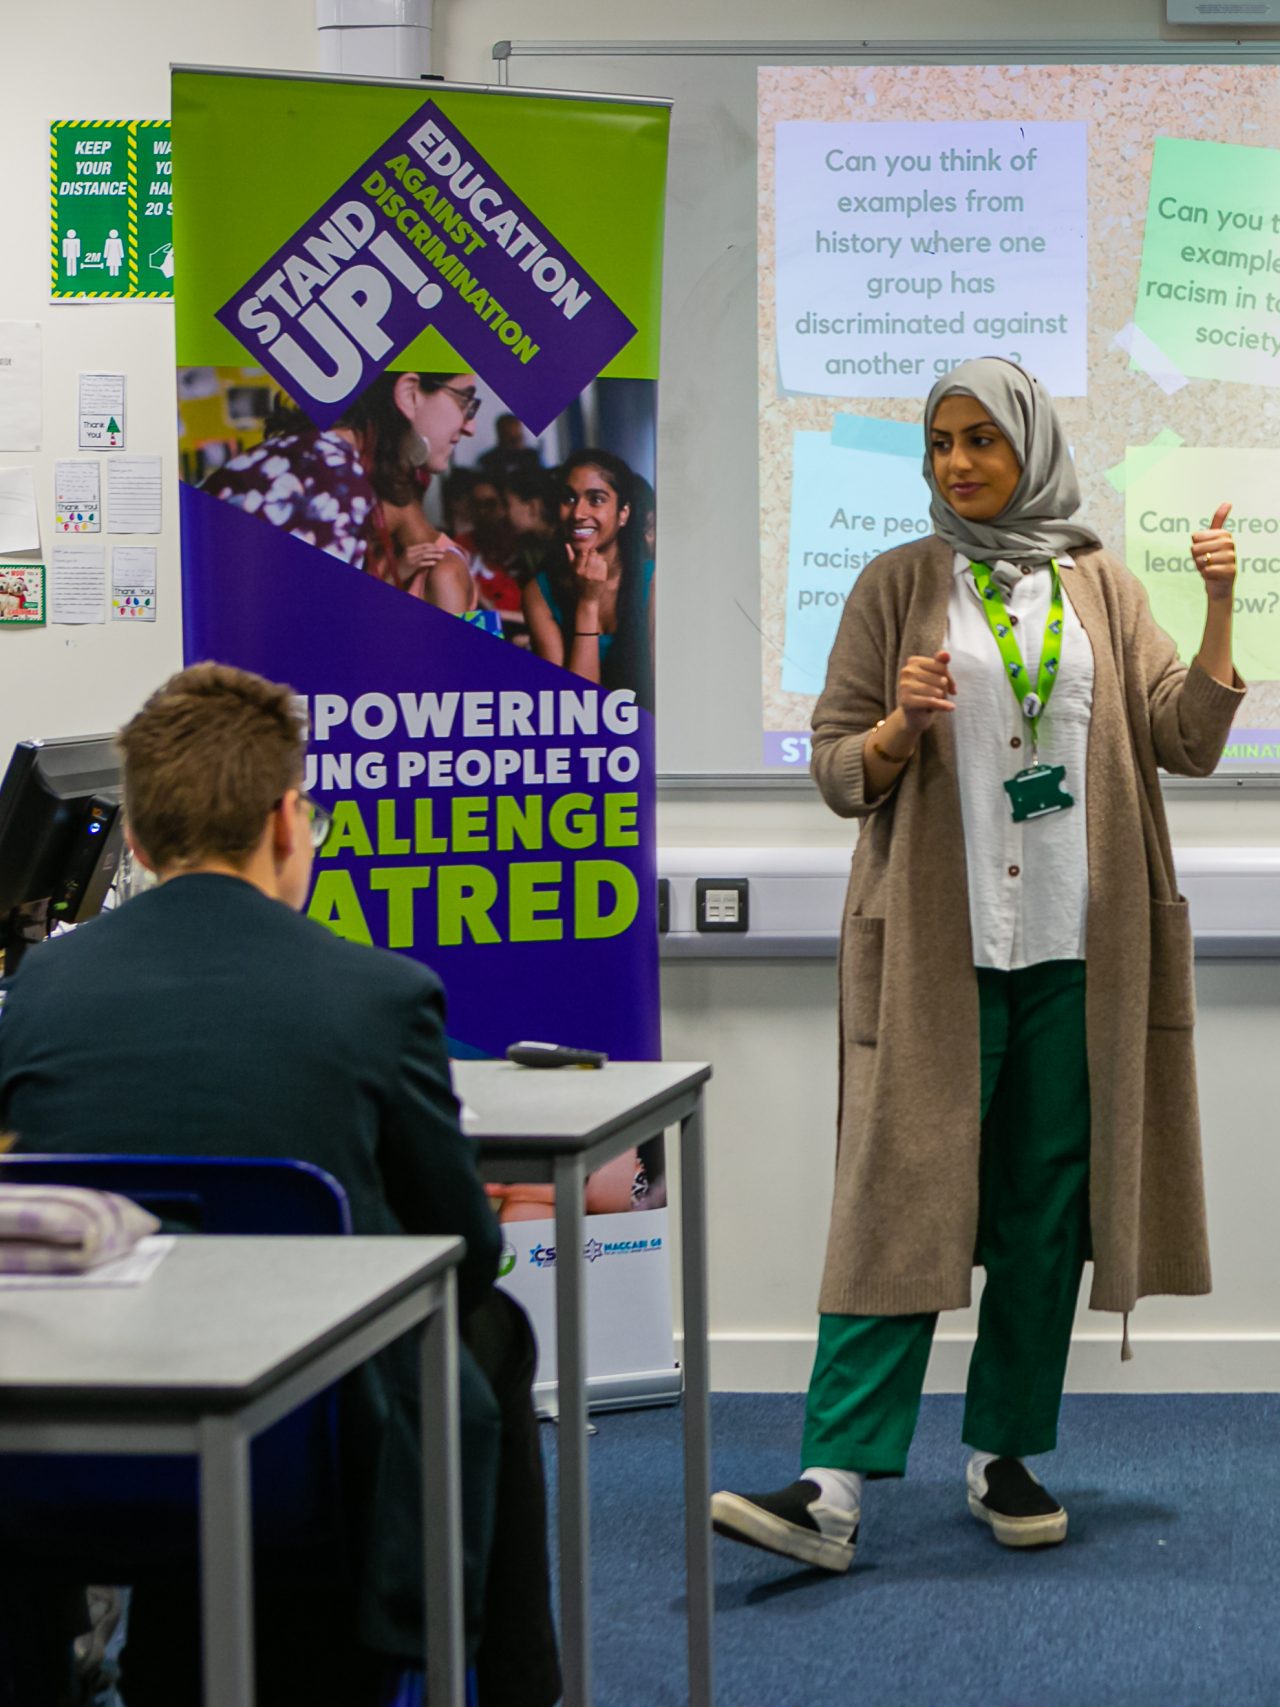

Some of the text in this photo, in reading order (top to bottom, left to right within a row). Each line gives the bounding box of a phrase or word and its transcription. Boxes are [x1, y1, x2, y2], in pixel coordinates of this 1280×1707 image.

[75, 141, 112, 155] KEEP
[825, 148, 1038, 177] Can you think of
[76, 161, 112, 175] YOUR
[60, 182, 127, 195] DISTANCE
[145, 202, 163, 215] 20
[384, 153, 486, 256] AGAINST
[837, 189, 1024, 219] examples from
[1157, 196, 1209, 225] Can
[1217, 207, 1263, 233] you
[407, 119, 592, 320] EDUCATION
[84, 252, 101, 262] 2M
[815, 230, 1046, 258] history where one
[238, 199, 377, 345] STAND
[361, 170, 540, 365] DISCRIMINATION
[867, 270, 995, 299] group has
[1145, 278, 1227, 307] racism
[1236, 285, 1256, 310] in
[268, 229, 444, 404] UP!
[795, 312, 1067, 339] discriminated against
[825, 352, 925, 374] another
[829, 508, 876, 531] Are
[1139, 511, 1190, 533] Can
[1232, 592, 1280, 614] ow?
[398, 747, 571, 788] PEOPLE
[580, 746, 640, 784] TO
[318, 792, 639, 858] ALLENGE
[307, 859, 640, 948] ATRED
